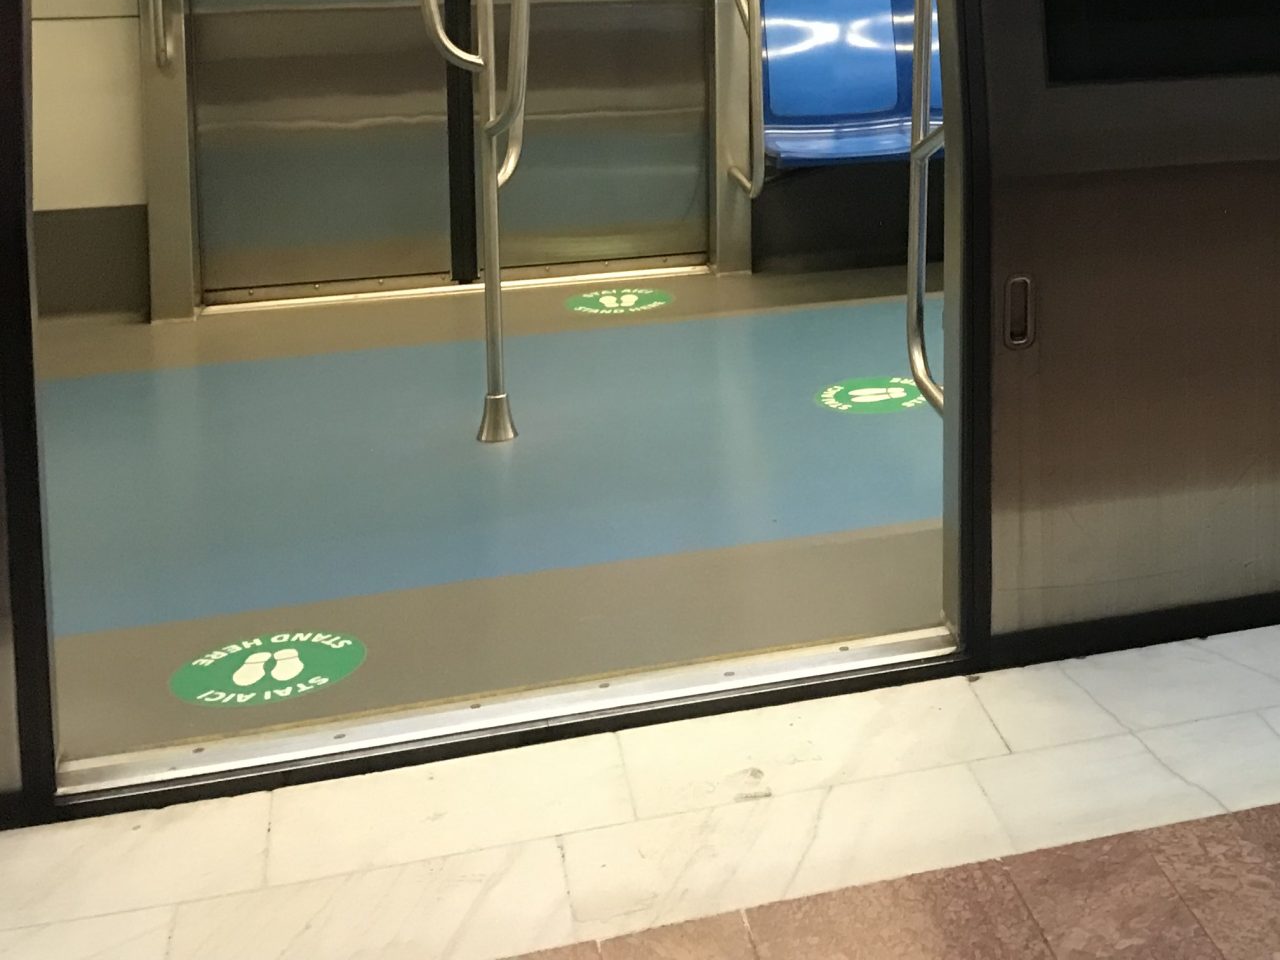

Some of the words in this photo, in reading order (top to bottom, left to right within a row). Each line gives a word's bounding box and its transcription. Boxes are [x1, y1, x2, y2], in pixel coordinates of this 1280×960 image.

[573, 306, 625, 314] STAND
[270, 632, 353, 649] STAND
[191, 638, 263, 667] HERE
[196, 689, 257, 704] AICI
[263, 676, 330, 701] STAI
